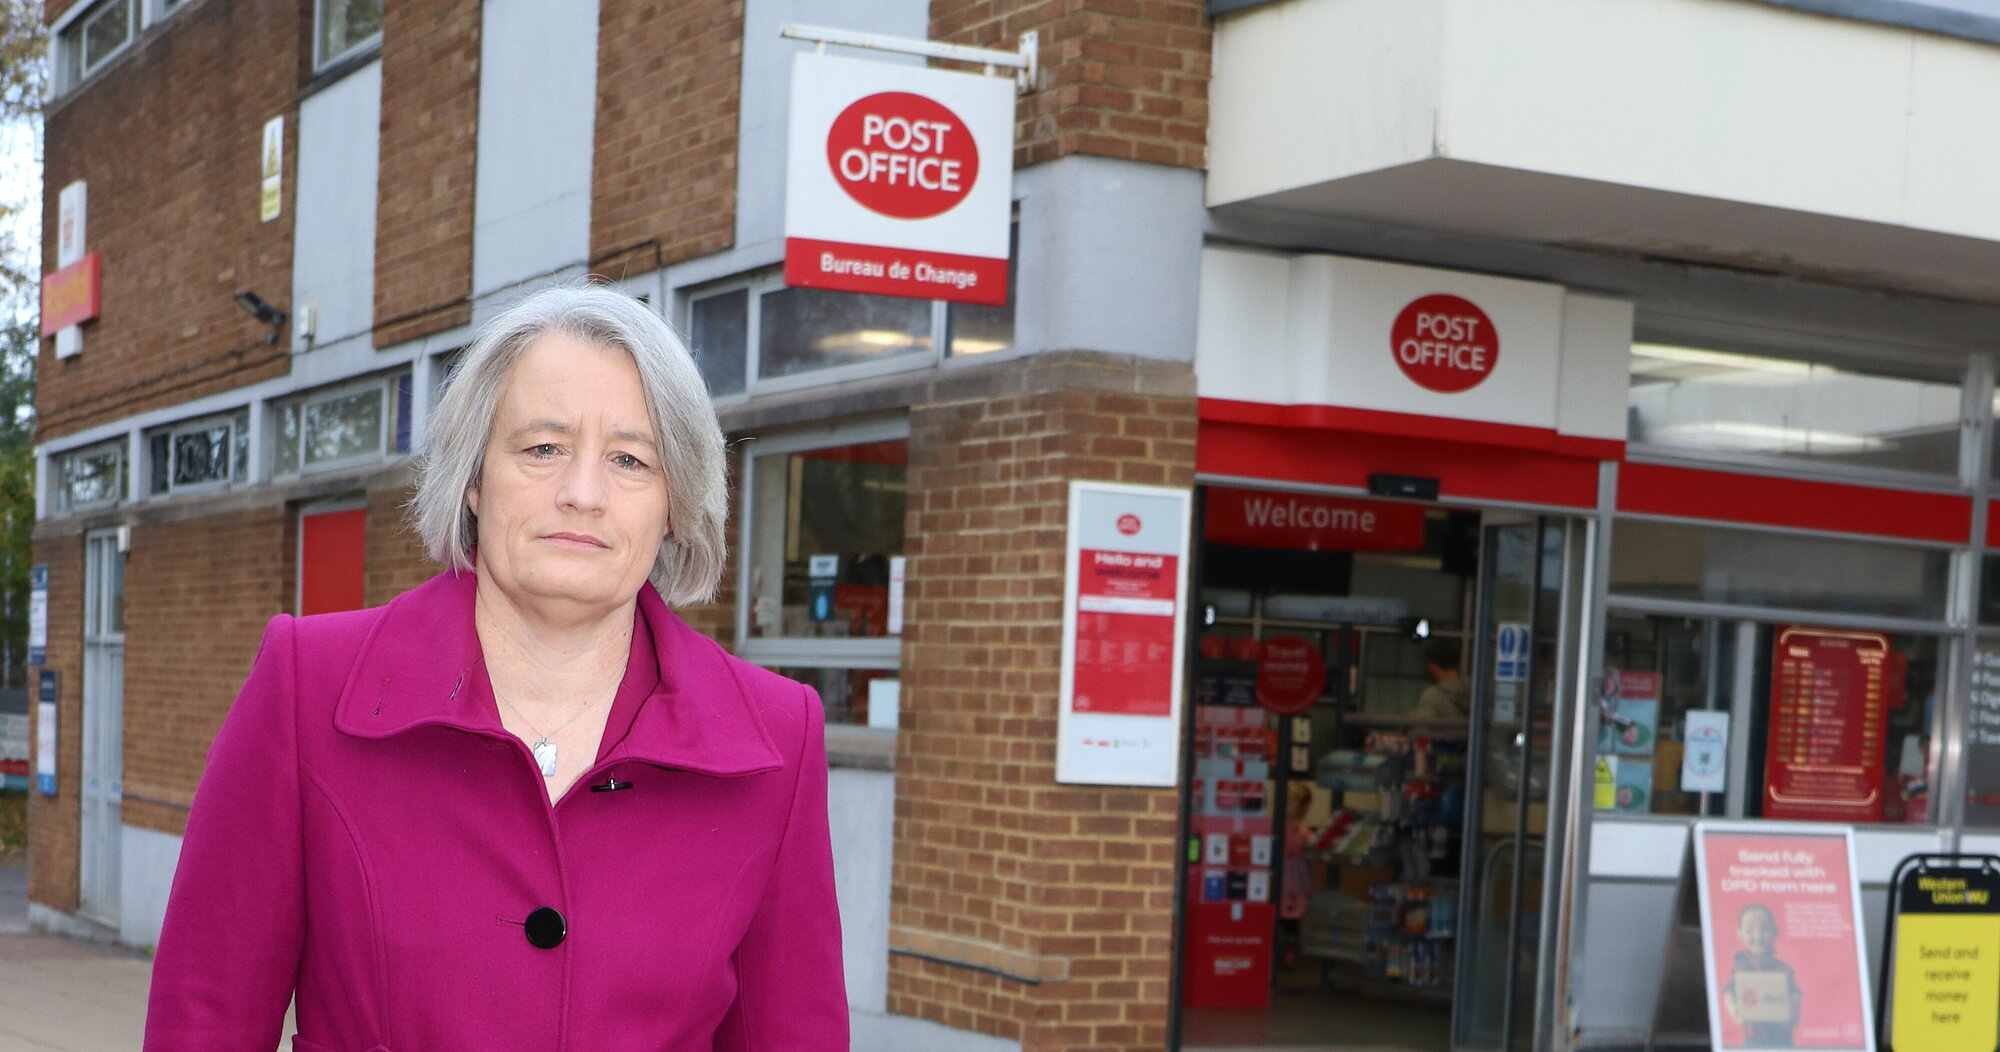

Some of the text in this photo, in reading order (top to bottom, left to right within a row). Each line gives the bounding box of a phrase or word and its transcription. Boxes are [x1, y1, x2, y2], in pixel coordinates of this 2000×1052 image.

[863, 114, 952, 154] POST
[839, 148, 961, 192] OFFICE
[820, 253, 978, 289] Bureau de Change
[1415, 312, 1479, 342] POST
[1400, 339, 1485, 371] OFFICE
[1243, 499, 1376, 532] Welcome
[1094, 552, 1131, 566] Hello
[1739, 850, 1814, 865] Send fully
[1730, 866, 1825, 878] tracked with
[1760, 880, 1797, 892] from
[1801, 880, 1836, 893] here
[1918, 877, 1966, 890] Western
[1932, 891, 1965, 904] Union
[1919, 946, 1979, 960] Send and
[1925, 969, 1971, 982] receive
[1926, 991, 1968, 1004] money
[1931, 1012, 1960, 1024] here
